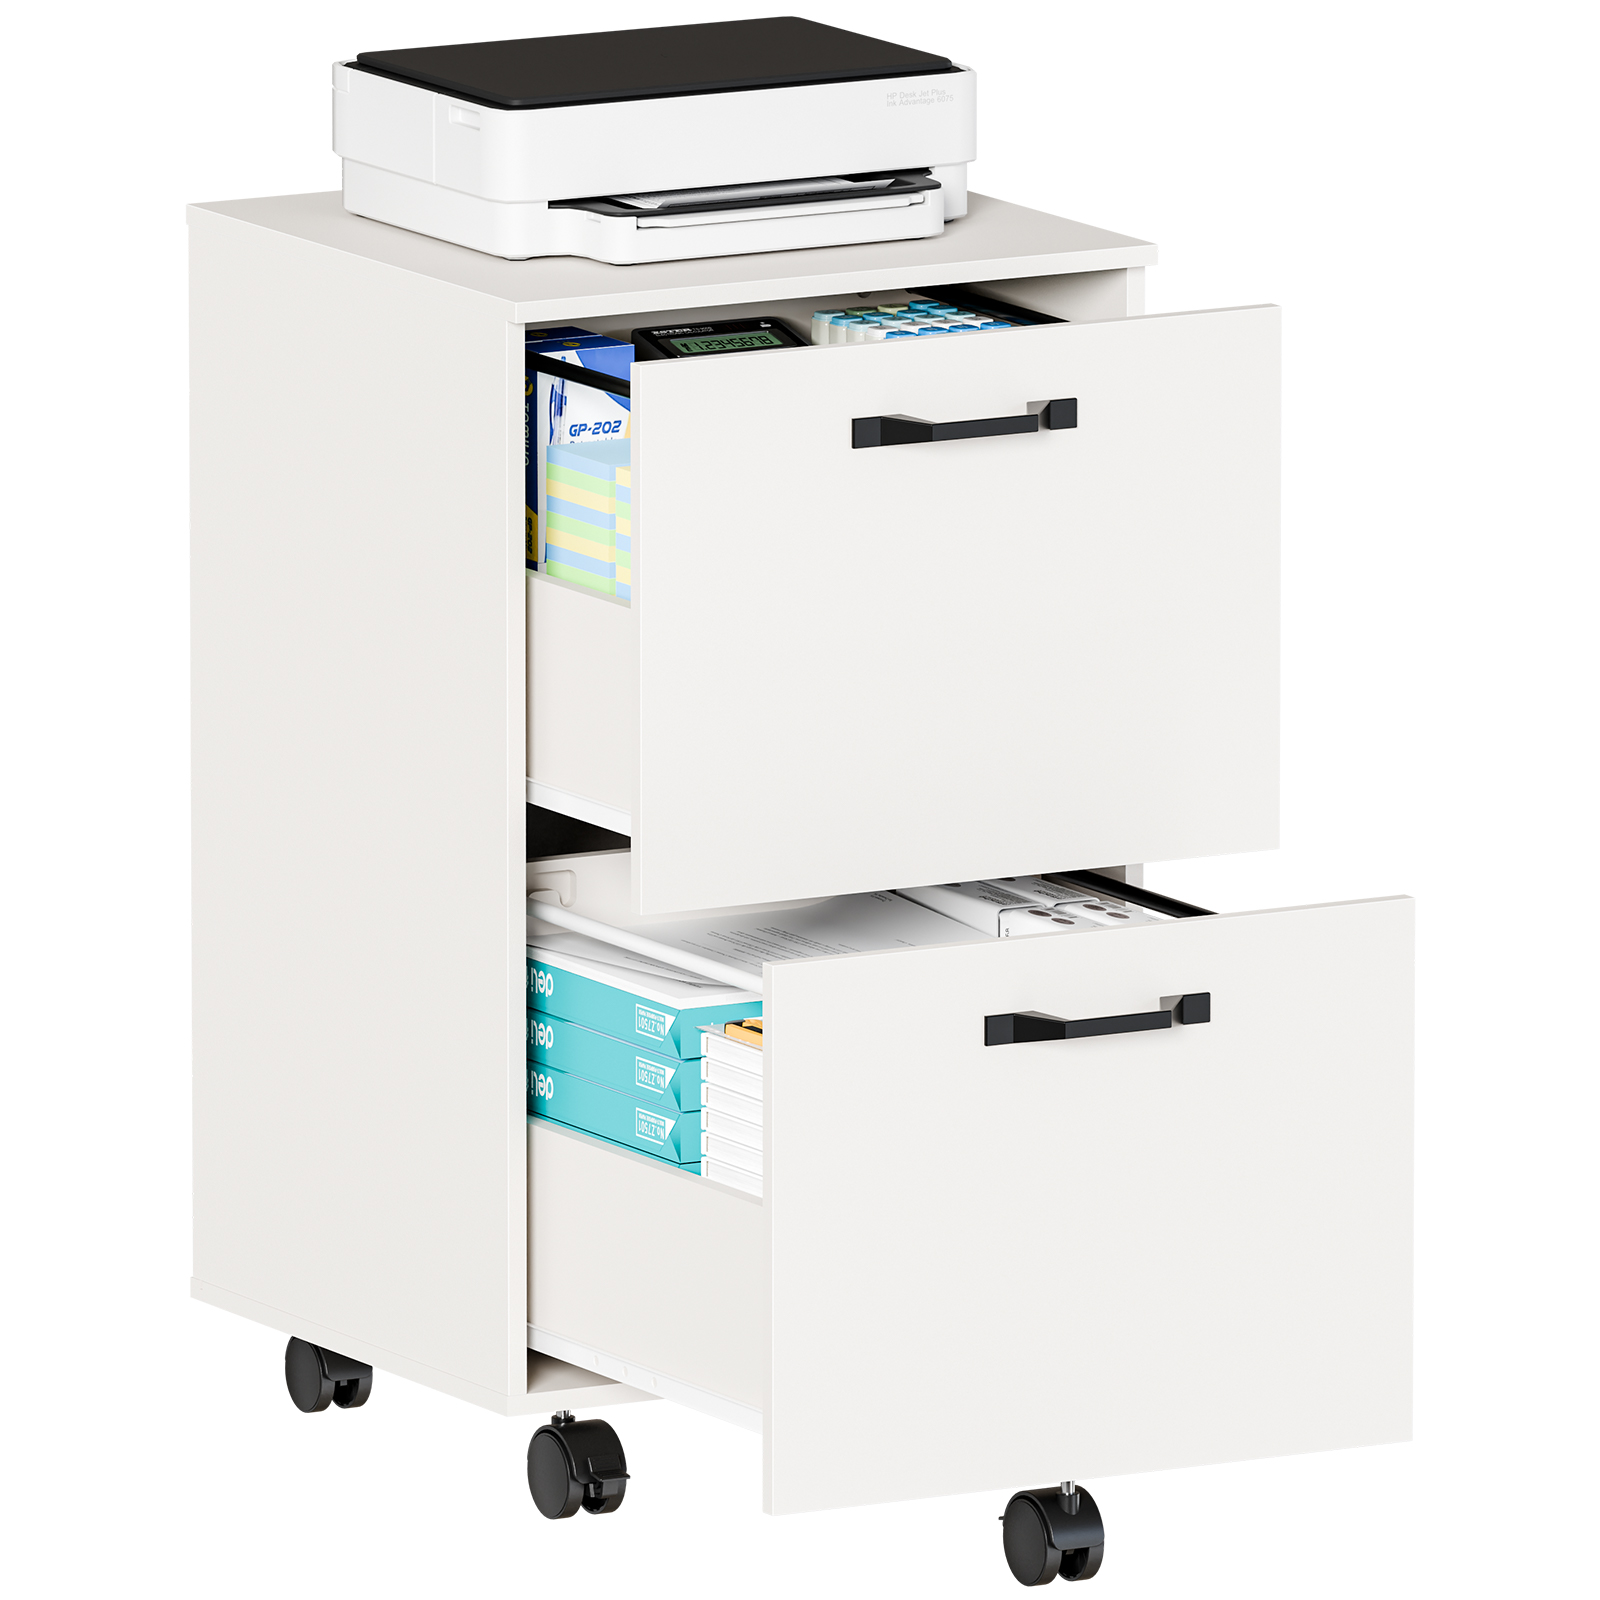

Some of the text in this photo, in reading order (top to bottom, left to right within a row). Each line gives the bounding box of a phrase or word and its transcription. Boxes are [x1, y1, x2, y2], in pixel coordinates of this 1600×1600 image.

[886, 92, 897, 100] HP
[899, 91, 917, 99] Desk
[931, 88, 946, 96] Plus
[899, 97, 935, 106] Advantage
[937, 94, 954, 103] 6075
[569, 420, 622, 437] GP-202
[530, 967, 554, 998] deli
[530, 1019, 554, 1050] deli
[530, 1070, 554, 1101] deli
